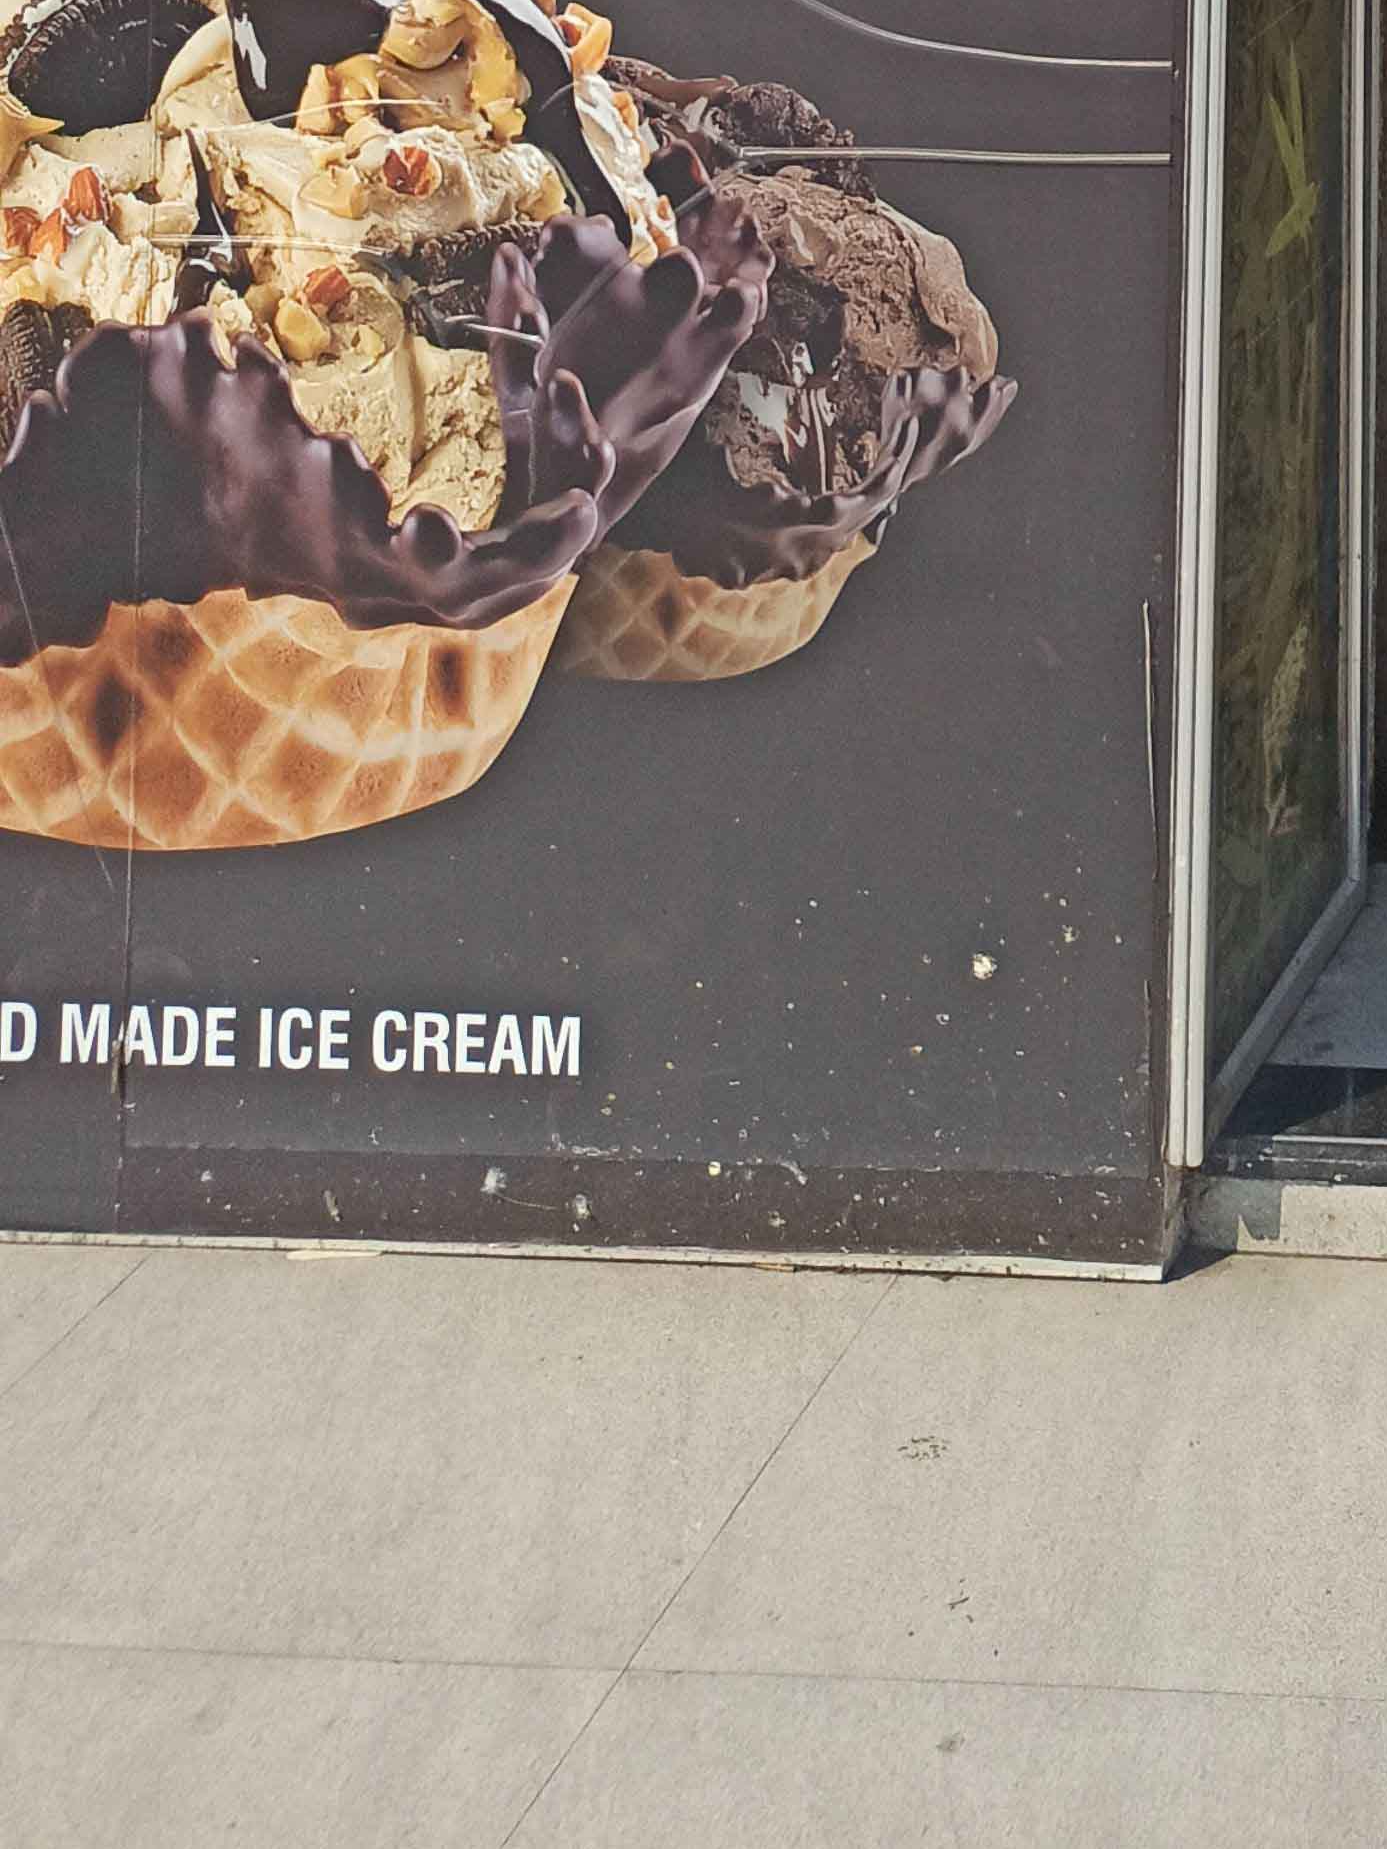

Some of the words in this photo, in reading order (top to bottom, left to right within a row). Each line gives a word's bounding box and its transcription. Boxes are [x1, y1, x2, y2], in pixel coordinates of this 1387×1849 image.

[59, 1002, 237, 1068] MADE
[258, 1008, 351, 1071] ICE
[371, 1009, 581, 1077] CREAM
